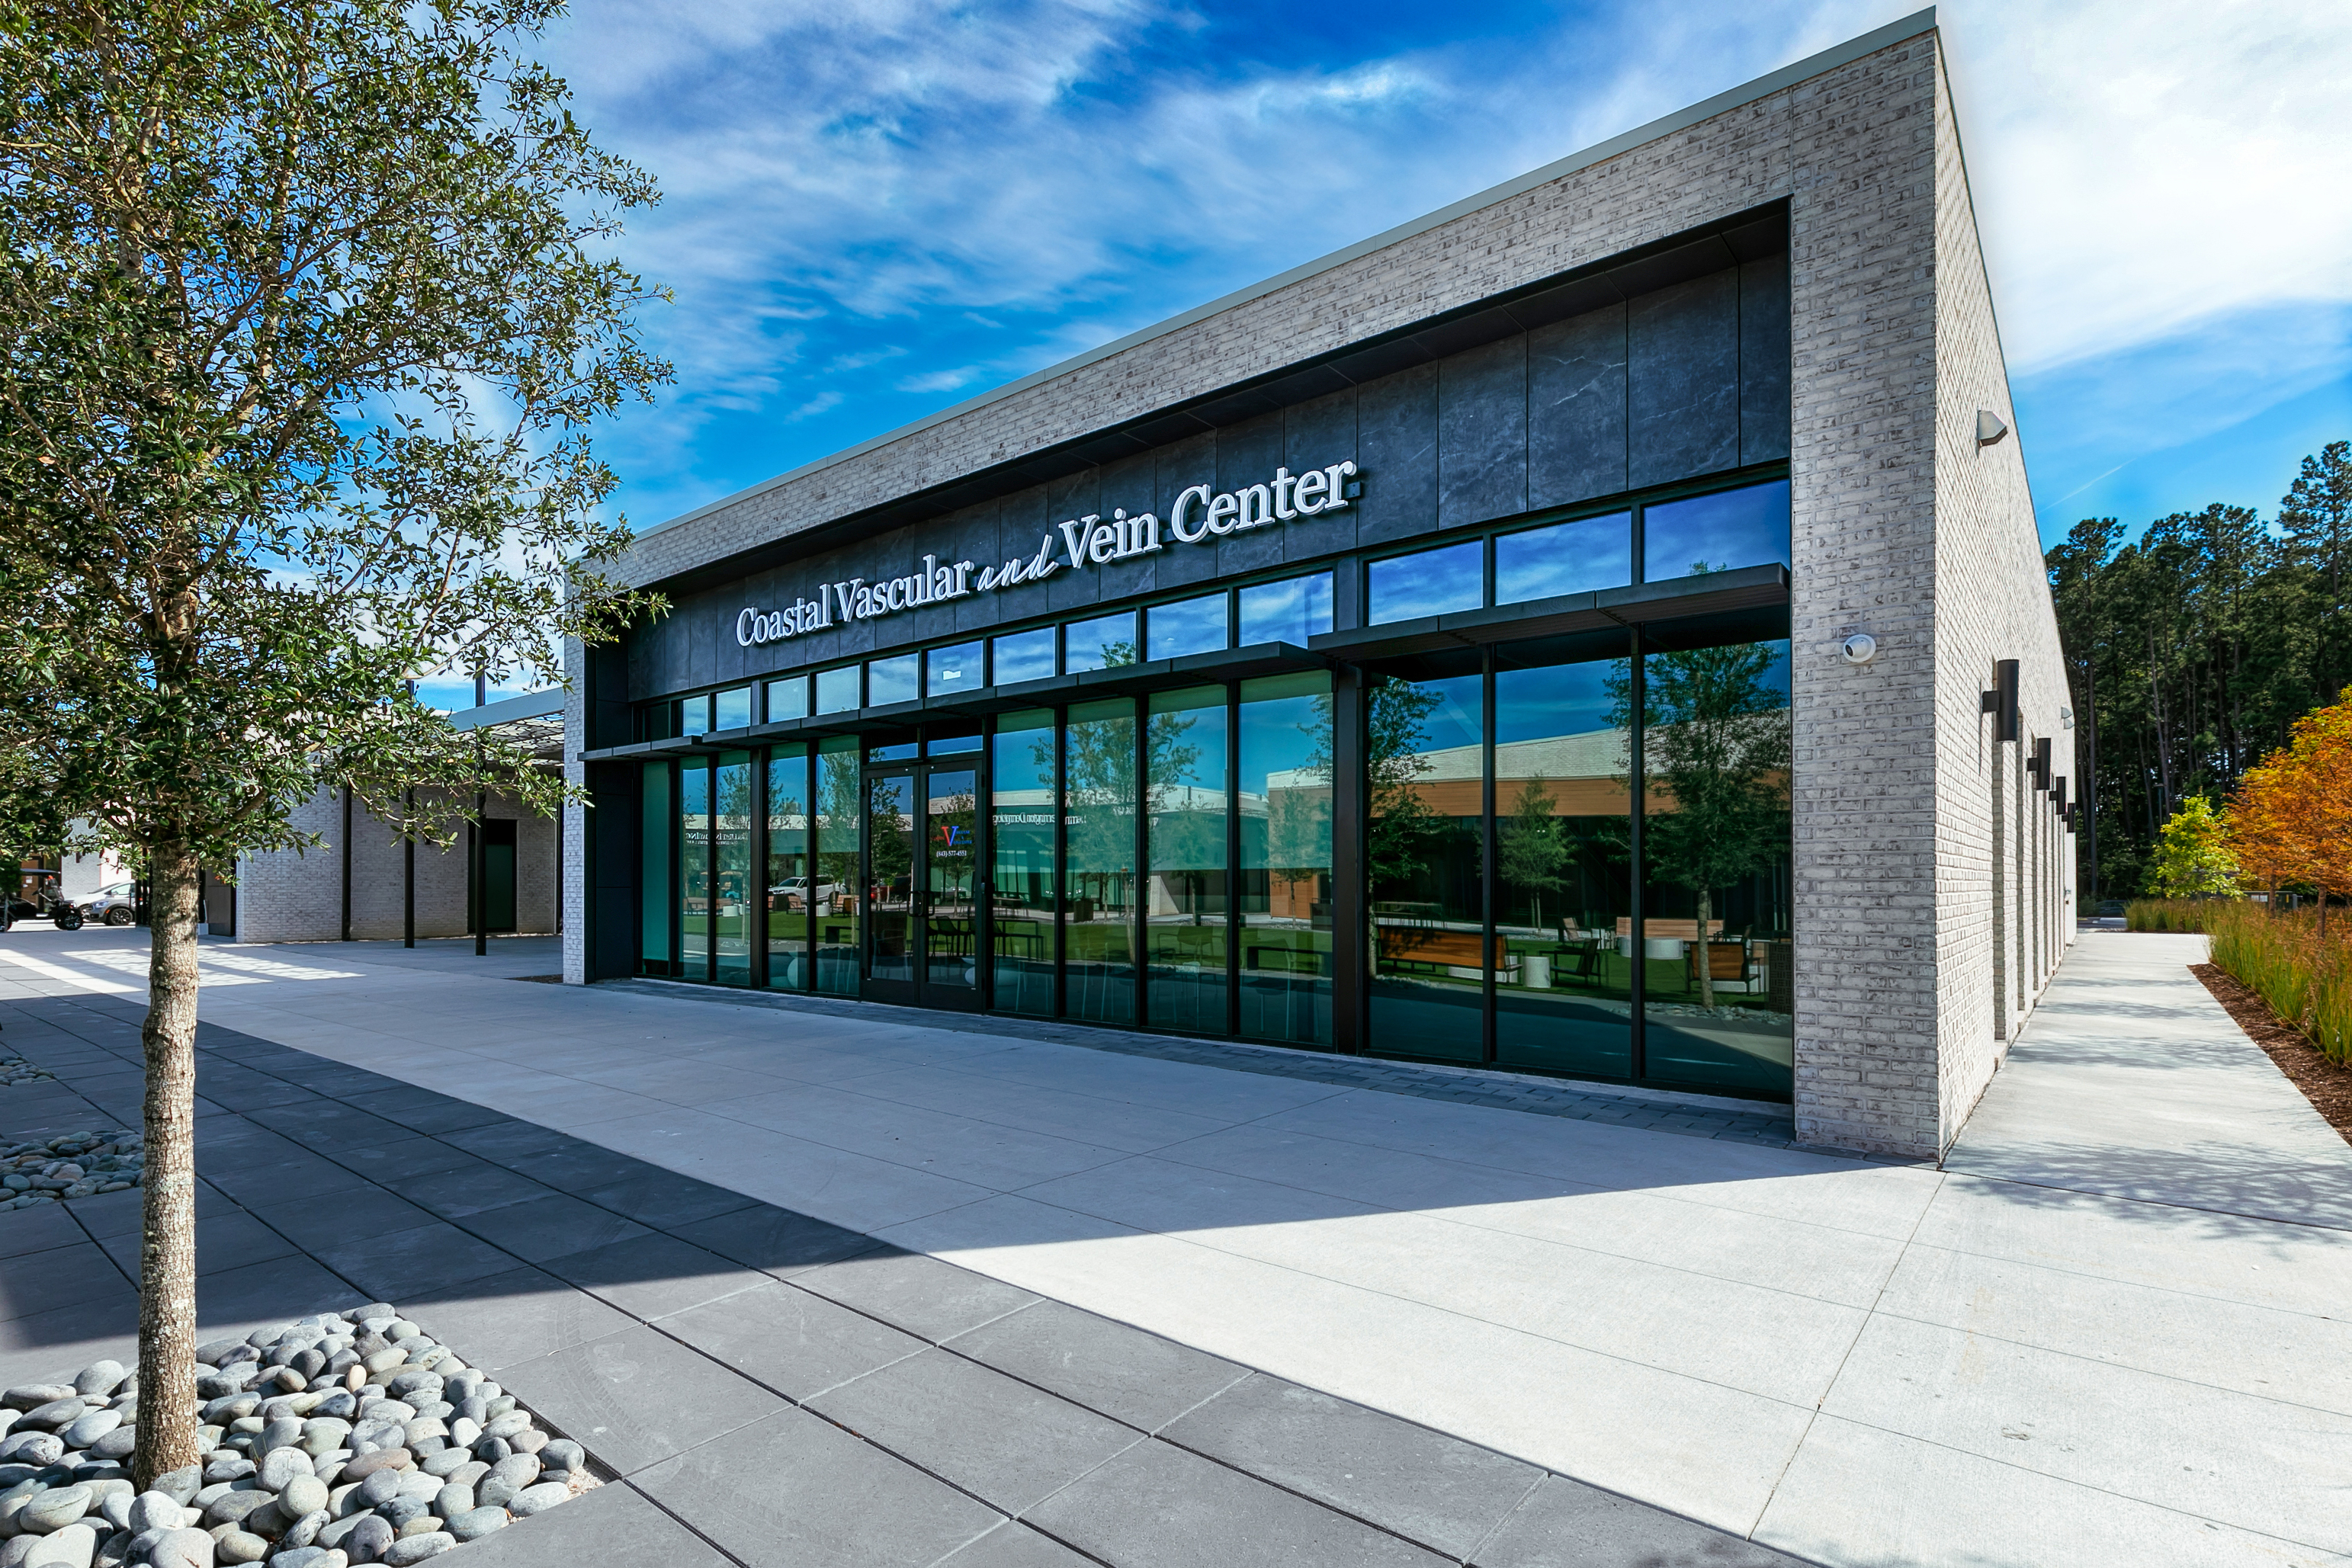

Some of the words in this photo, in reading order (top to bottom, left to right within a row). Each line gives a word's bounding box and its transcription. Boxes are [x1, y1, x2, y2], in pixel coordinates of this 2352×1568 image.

[736, 584, 833, 647] Coastal
[834, 553, 975, 623] Vascular
[977, 534, 1059, 592] and
[1058, 508, 1163, 569] Vein
[1171, 460, 1357, 544] Center
